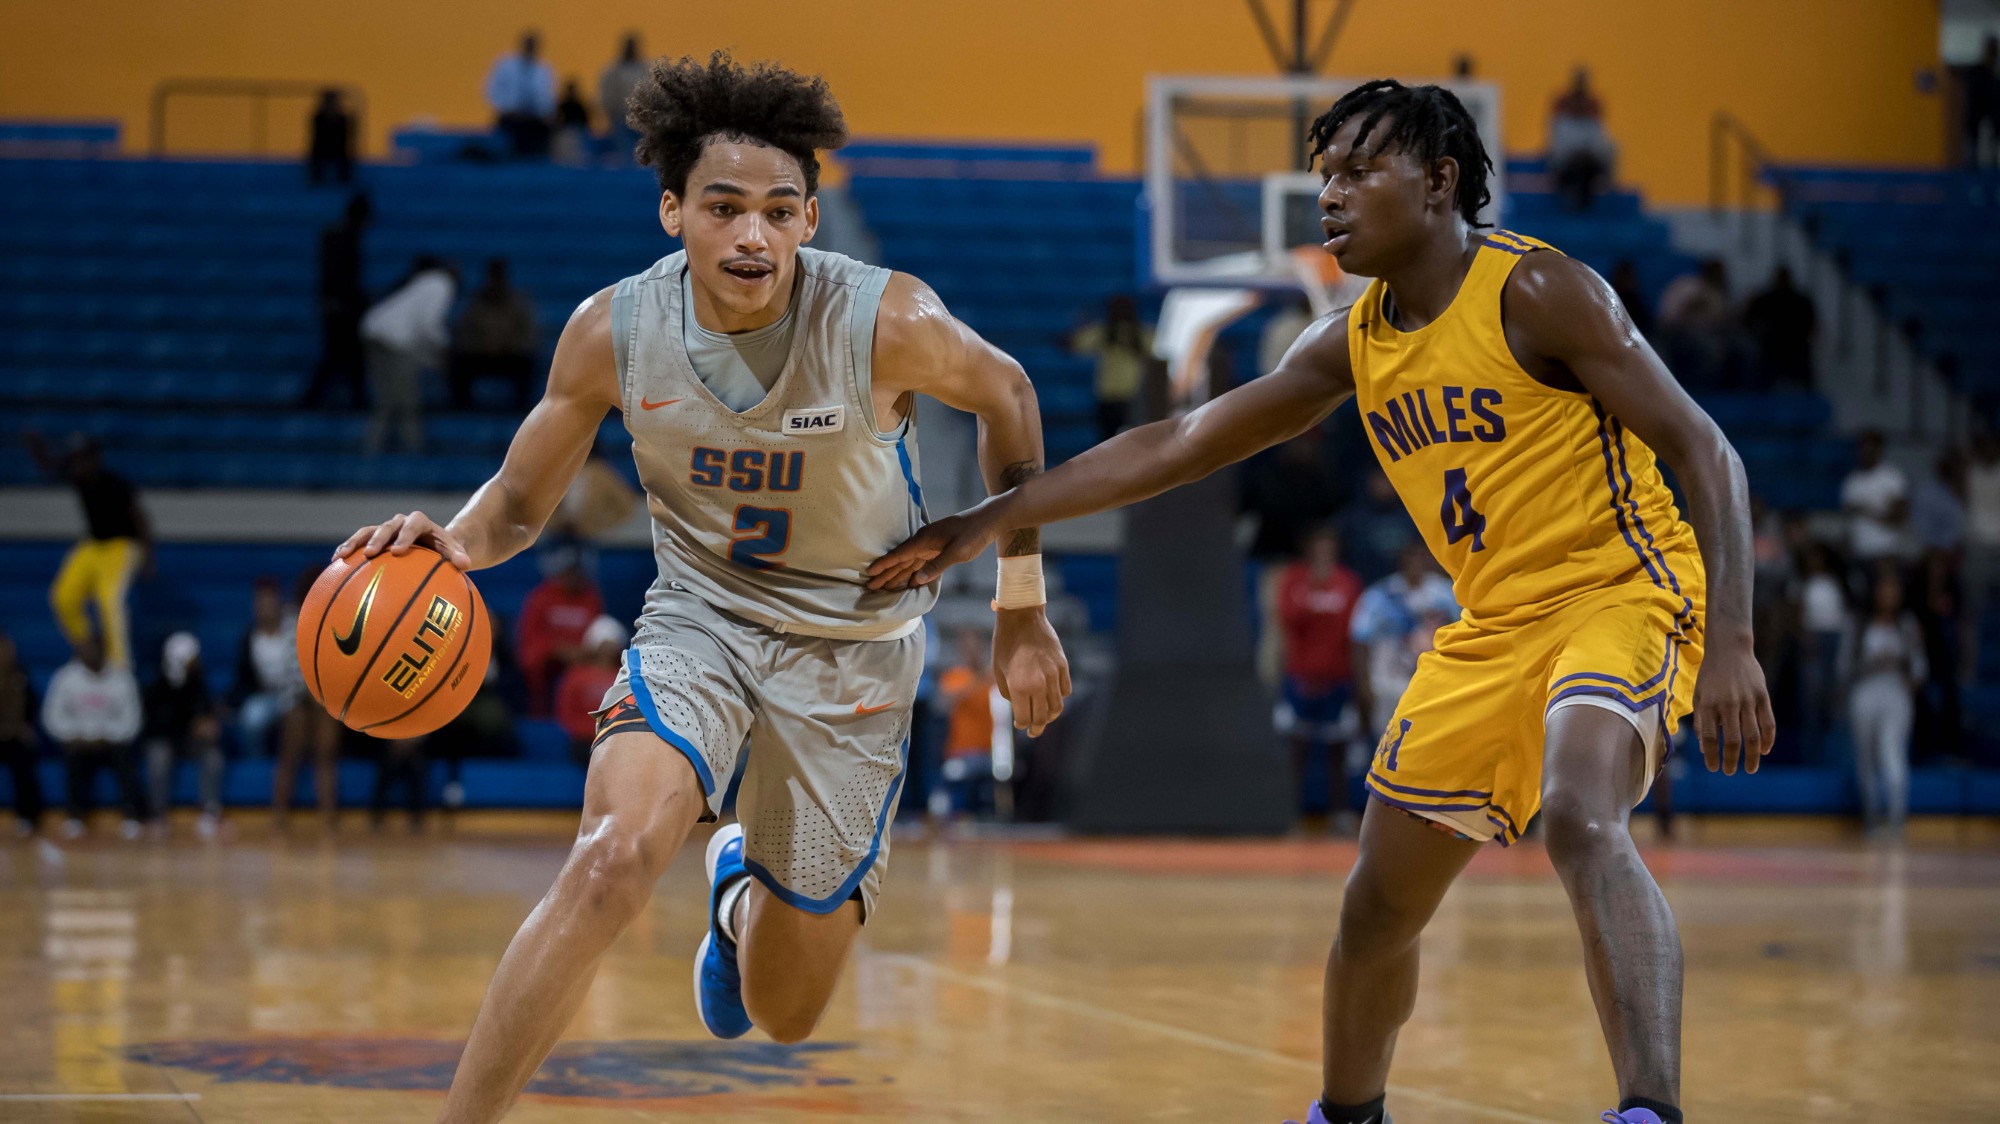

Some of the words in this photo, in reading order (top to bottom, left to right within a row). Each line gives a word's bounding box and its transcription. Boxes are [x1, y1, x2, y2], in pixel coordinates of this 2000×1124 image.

[790, 414, 836, 428] SIAC
[1367, 386, 1506, 462] MILES
[690, 447, 804, 492] SSU
[728, 505, 792, 571] 2
[1441, 467, 1486, 552] 4
[381, 595, 458, 695] ELITE
[404, 612, 463, 700] CHAMPIONSHIP
